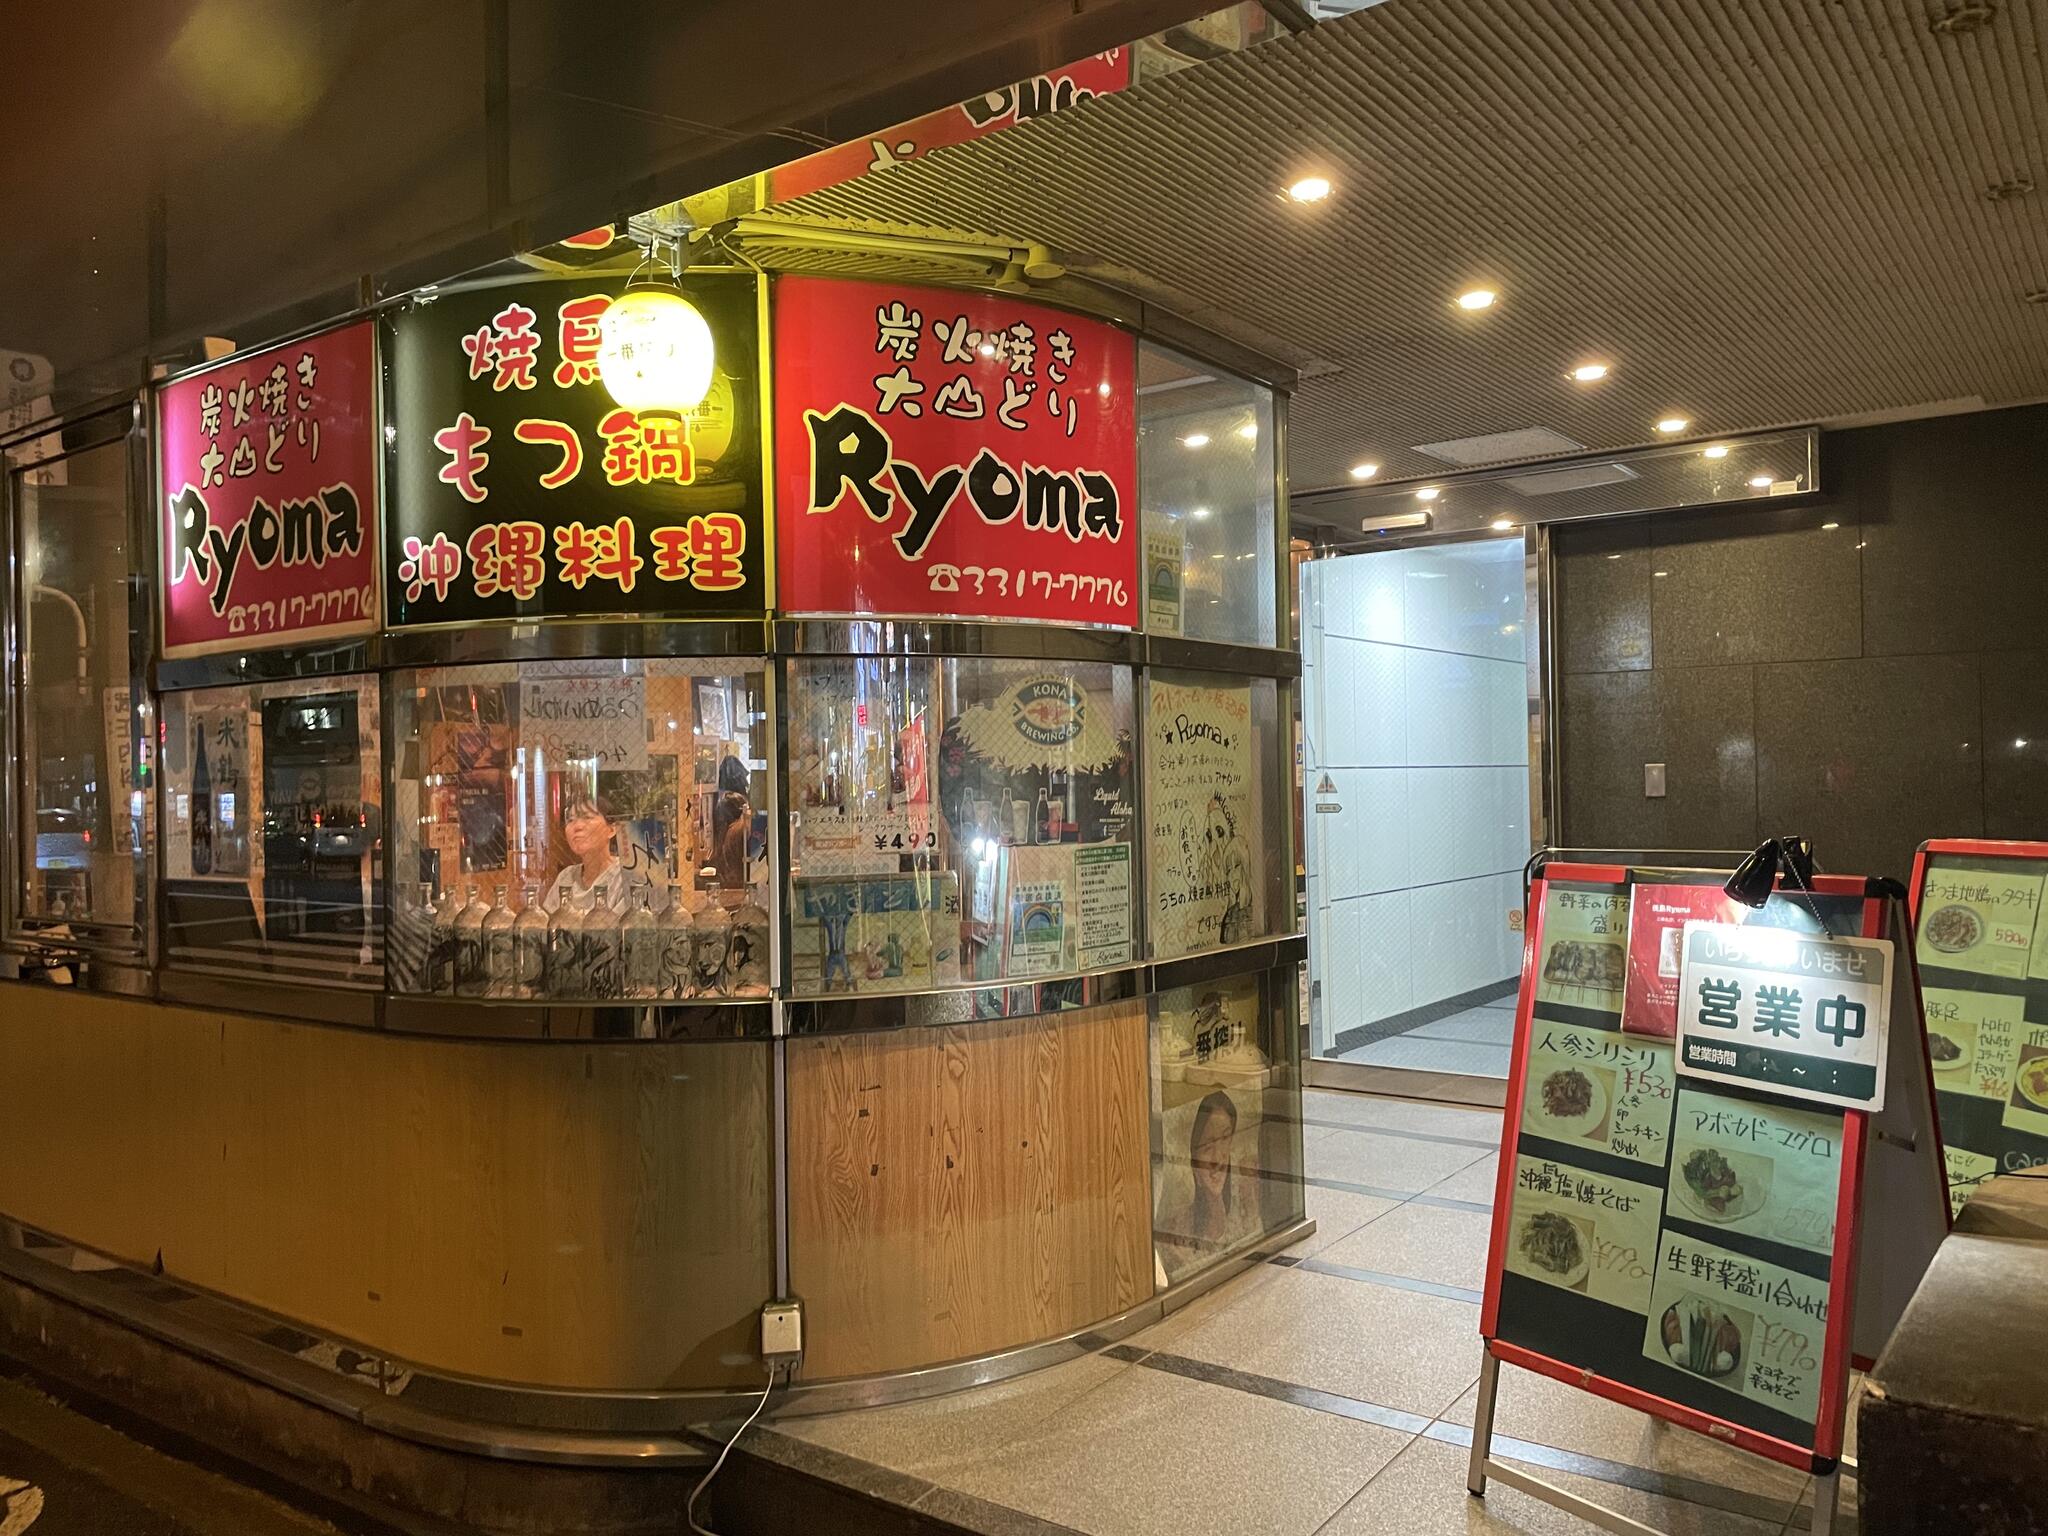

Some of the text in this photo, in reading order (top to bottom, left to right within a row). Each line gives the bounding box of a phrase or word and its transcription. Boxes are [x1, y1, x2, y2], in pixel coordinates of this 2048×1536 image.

[876, 301, 1075, 384] 炭火焼き
[201, 353, 318, 440] 炭火焼き
[874, 366, 1077, 437] 大山どり
[201, 420, 319, 490] 大山どり
[434, 407, 695, 503] もつ鍋
[803, 402, 1123, 561] Ryoma
[169, 482, 363, 618] Ryoma
[399, 512, 746, 603] 沖縄料理
[963, 565, 1128, 607] 3317-7776
[247, 585, 373, 632] 3317-7776
[1032, 684, 1067, 700] KONA
[1020, 721, 1064, 741] BREWING
[1175, 714, 1221, 745] Ryoma
[1093, 788, 1121, 805] Liquid
[1110, 802, 1133, 815] Aloha
[874, 832, 937, 851] ¥490
[1590, 915, 1629, 934] 盛り
[1705, 936, 1867, 976] いらいませ
[1698, 977, 1867, 1047] 営業中
[1689, 1044, 1737, 1067] 営業時間
[1624, 1067, 1672, 1099] ¥530
